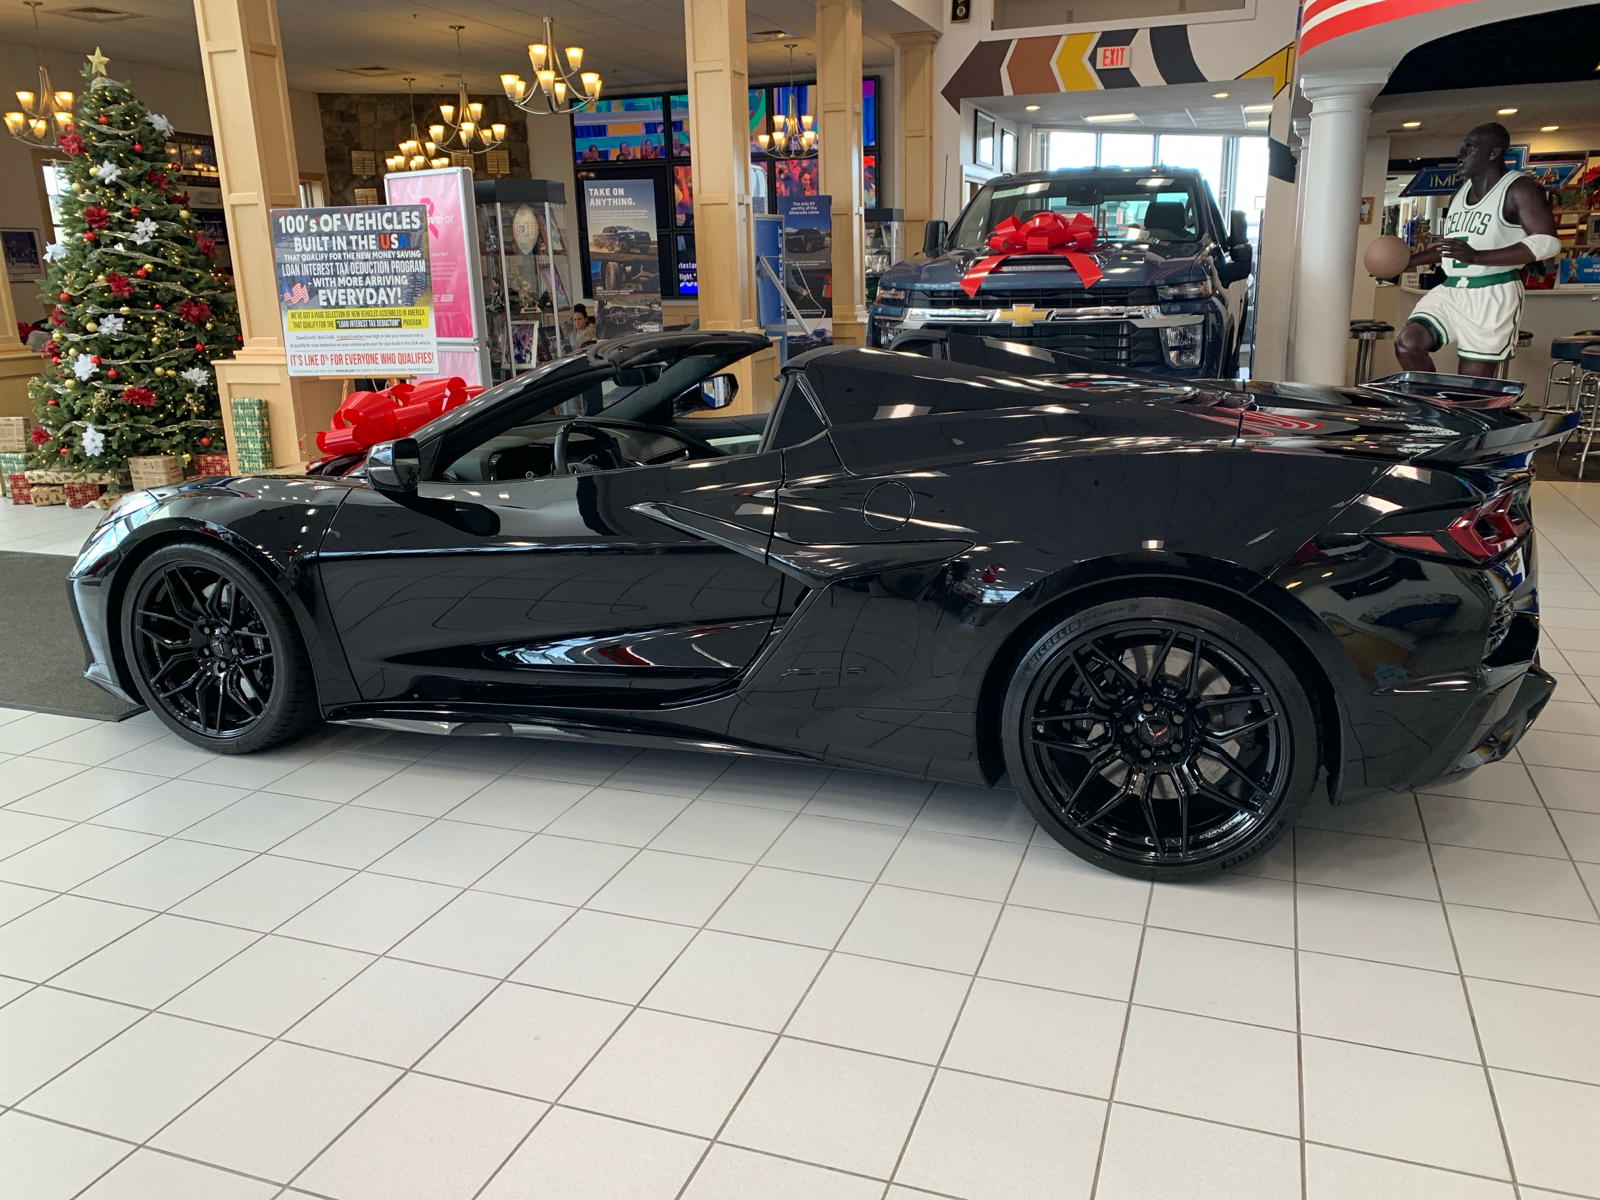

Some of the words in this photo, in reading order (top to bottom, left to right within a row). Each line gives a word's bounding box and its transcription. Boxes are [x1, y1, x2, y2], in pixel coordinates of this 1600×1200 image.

[1102, 47, 1126, 67] EXIT
[588, 187, 611, 196] TAKE
[612, 187, 625, 196] ON
[589, 197, 636, 207] ANYTHING.
[278, 214, 317, 234] 100's
[319, 213, 341, 232] OF
[343, 210, 421, 232] VEHICLES
[1445, 210, 1492, 236] CELTICS
[294, 235, 329, 253] BUILT
[332, 235, 348, 252] IN
[349, 234, 377, 251] THE
[380, 233, 410, 249] USA
[284, 254, 301, 262] THAT
[301, 253, 329, 262] QUALIFY
[329, 252, 343, 260] FOR
[343, 252, 356, 260] THE
[356, 251, 374, 260] NEW
[374, 251, 396, 259] MONEY
[396, 250, 422, 258] SAVING
[281, 263, 301, 277] LOAN
[301, 262, 335, 276] INTEREST
[335, 261, 350, 275] TAX
[350, 260, 391, 274] DEDUCTION
[391, 259, 426, 273] PROGRAM
[312, 277, 336, 288] WITH
[340, 276, 363, 287] MORE
[364, 275, 408, 286] ARRIVING
[318, 287, 402, 307] EVERYDAY!
[303, 311, 311, 319] GOT
[325, 310, 345, 318] SELECTION
[346, 310, 351, 318] OF
[360, 309, 379, 317] VEHICLES
[379, 309, 402, 317] ASSEMBLED
[302, 321, 318, 329] QUALIFY
[326, 320, 334, 328] THE
[350, 319, 368, 328] INTEREST
[368, 319, 376, 327] TAX
[290, 354, 303, 366] IT'S
[303, 354, 319, 366] LIKE
[330, 353, 343, 366] FOR
[344, 352, 379, 365] EVERYONE
[380, 352, 397, 365] WHO
[397, 351, 435, 365] QUALIFIES!
[1028, 620, 1080, 669] MICHELIN
